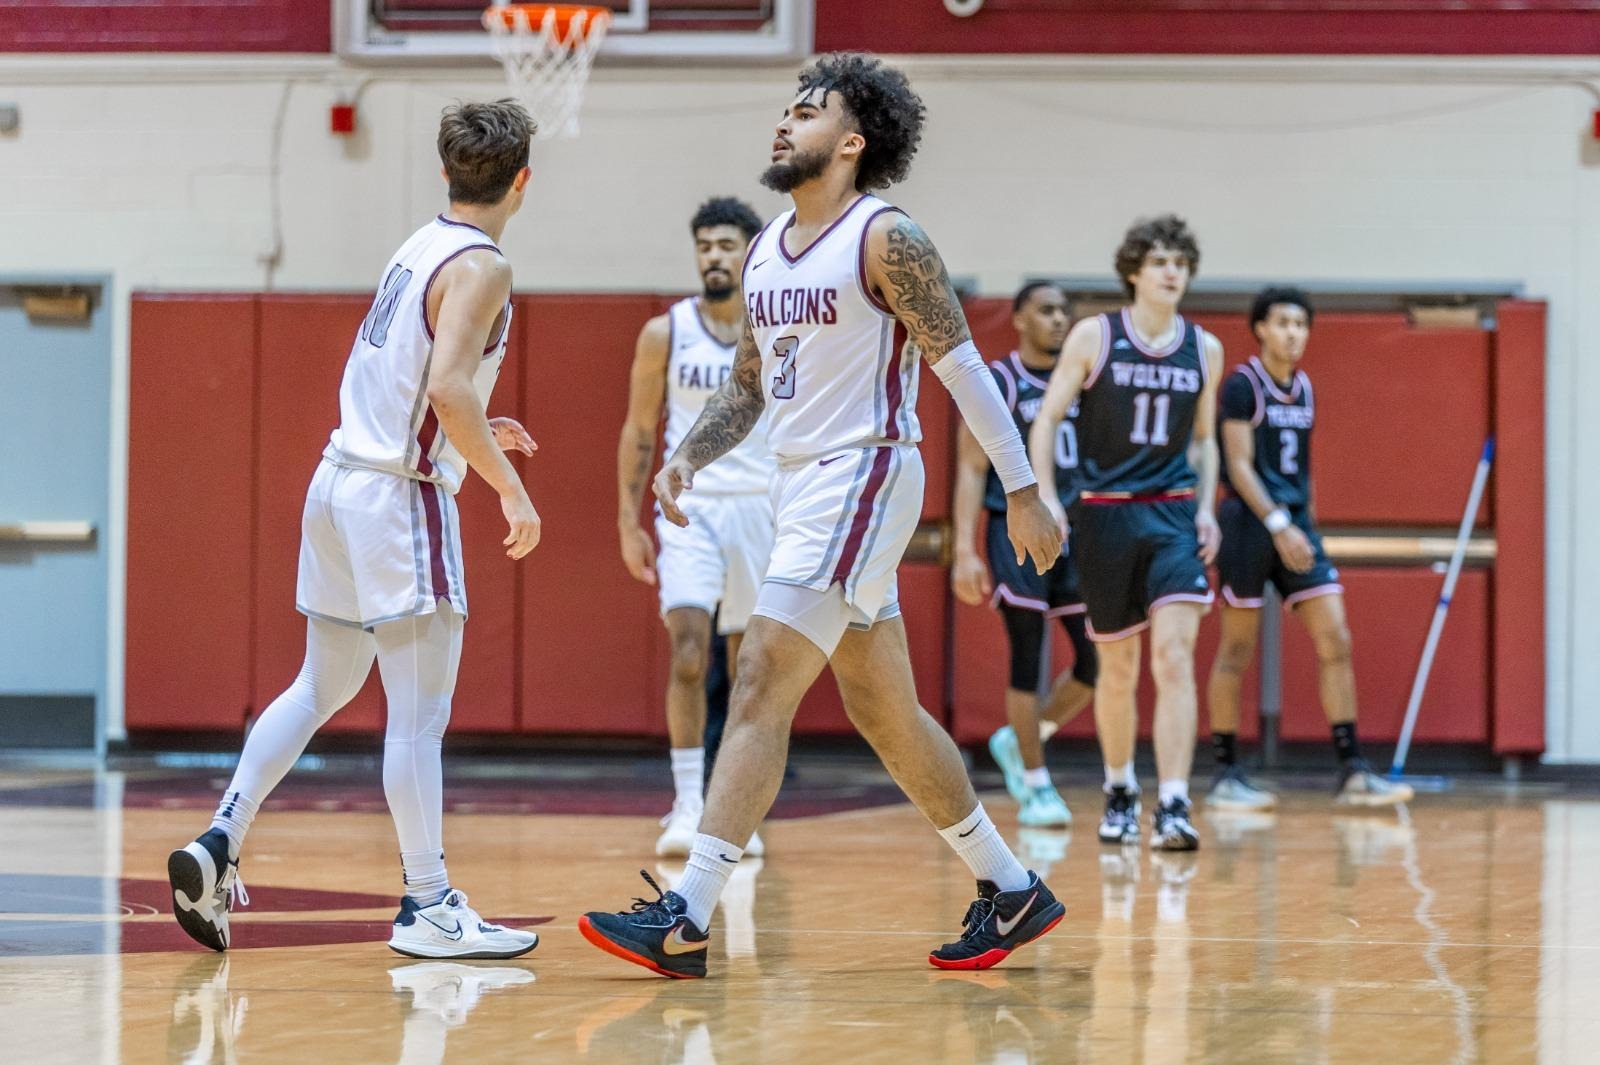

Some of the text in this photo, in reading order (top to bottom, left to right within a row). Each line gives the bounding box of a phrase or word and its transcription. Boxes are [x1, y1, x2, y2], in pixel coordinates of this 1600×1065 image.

[362, 263, 413, 348] 10
[749, 288, 837, 329] FALCONS
[678, 363, 730, 389] FALC
[771, 335, 800, 400] 3
[1110, 361, 1200, 393] WOLVES
[1129, 392, 1171, 446] 11
[1279, 428, 1299, 475] 2
